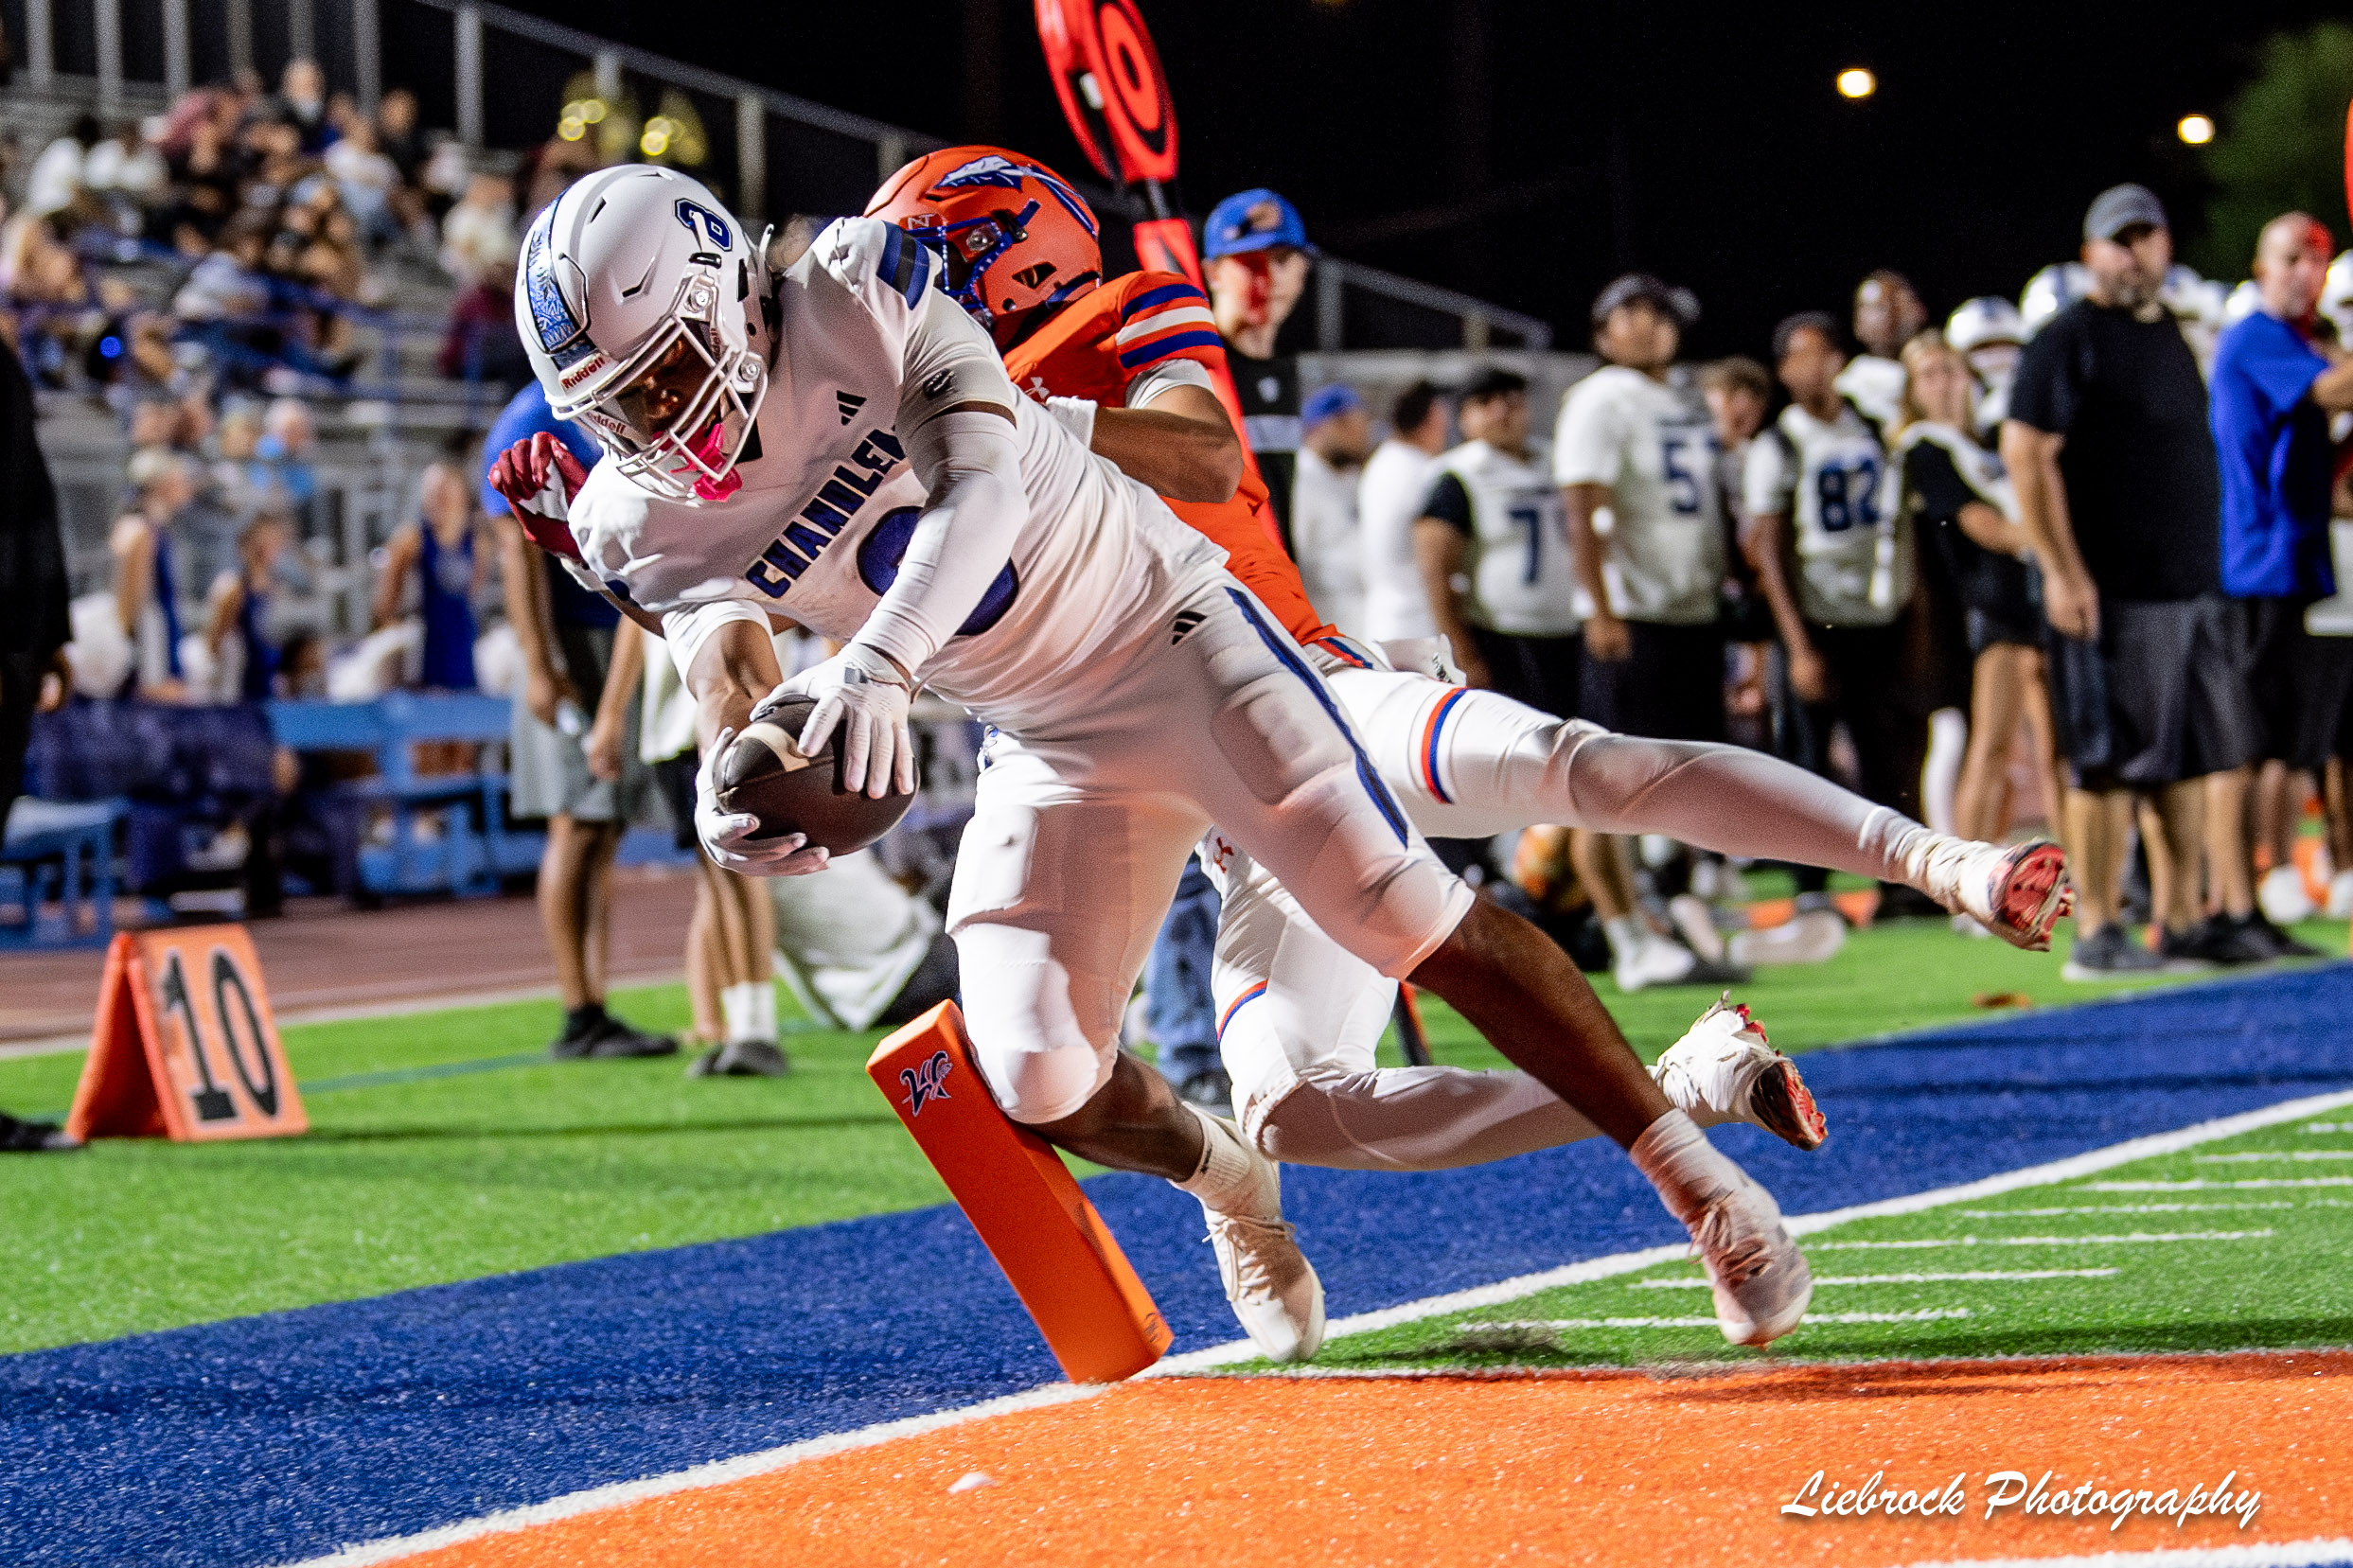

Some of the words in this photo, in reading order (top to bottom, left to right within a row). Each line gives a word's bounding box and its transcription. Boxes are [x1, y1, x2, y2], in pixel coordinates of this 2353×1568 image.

[561, 357, 606, 389] Riddell
[1818, 458, 1879, 531] 82
[161, 950, 278, 1122] 10
